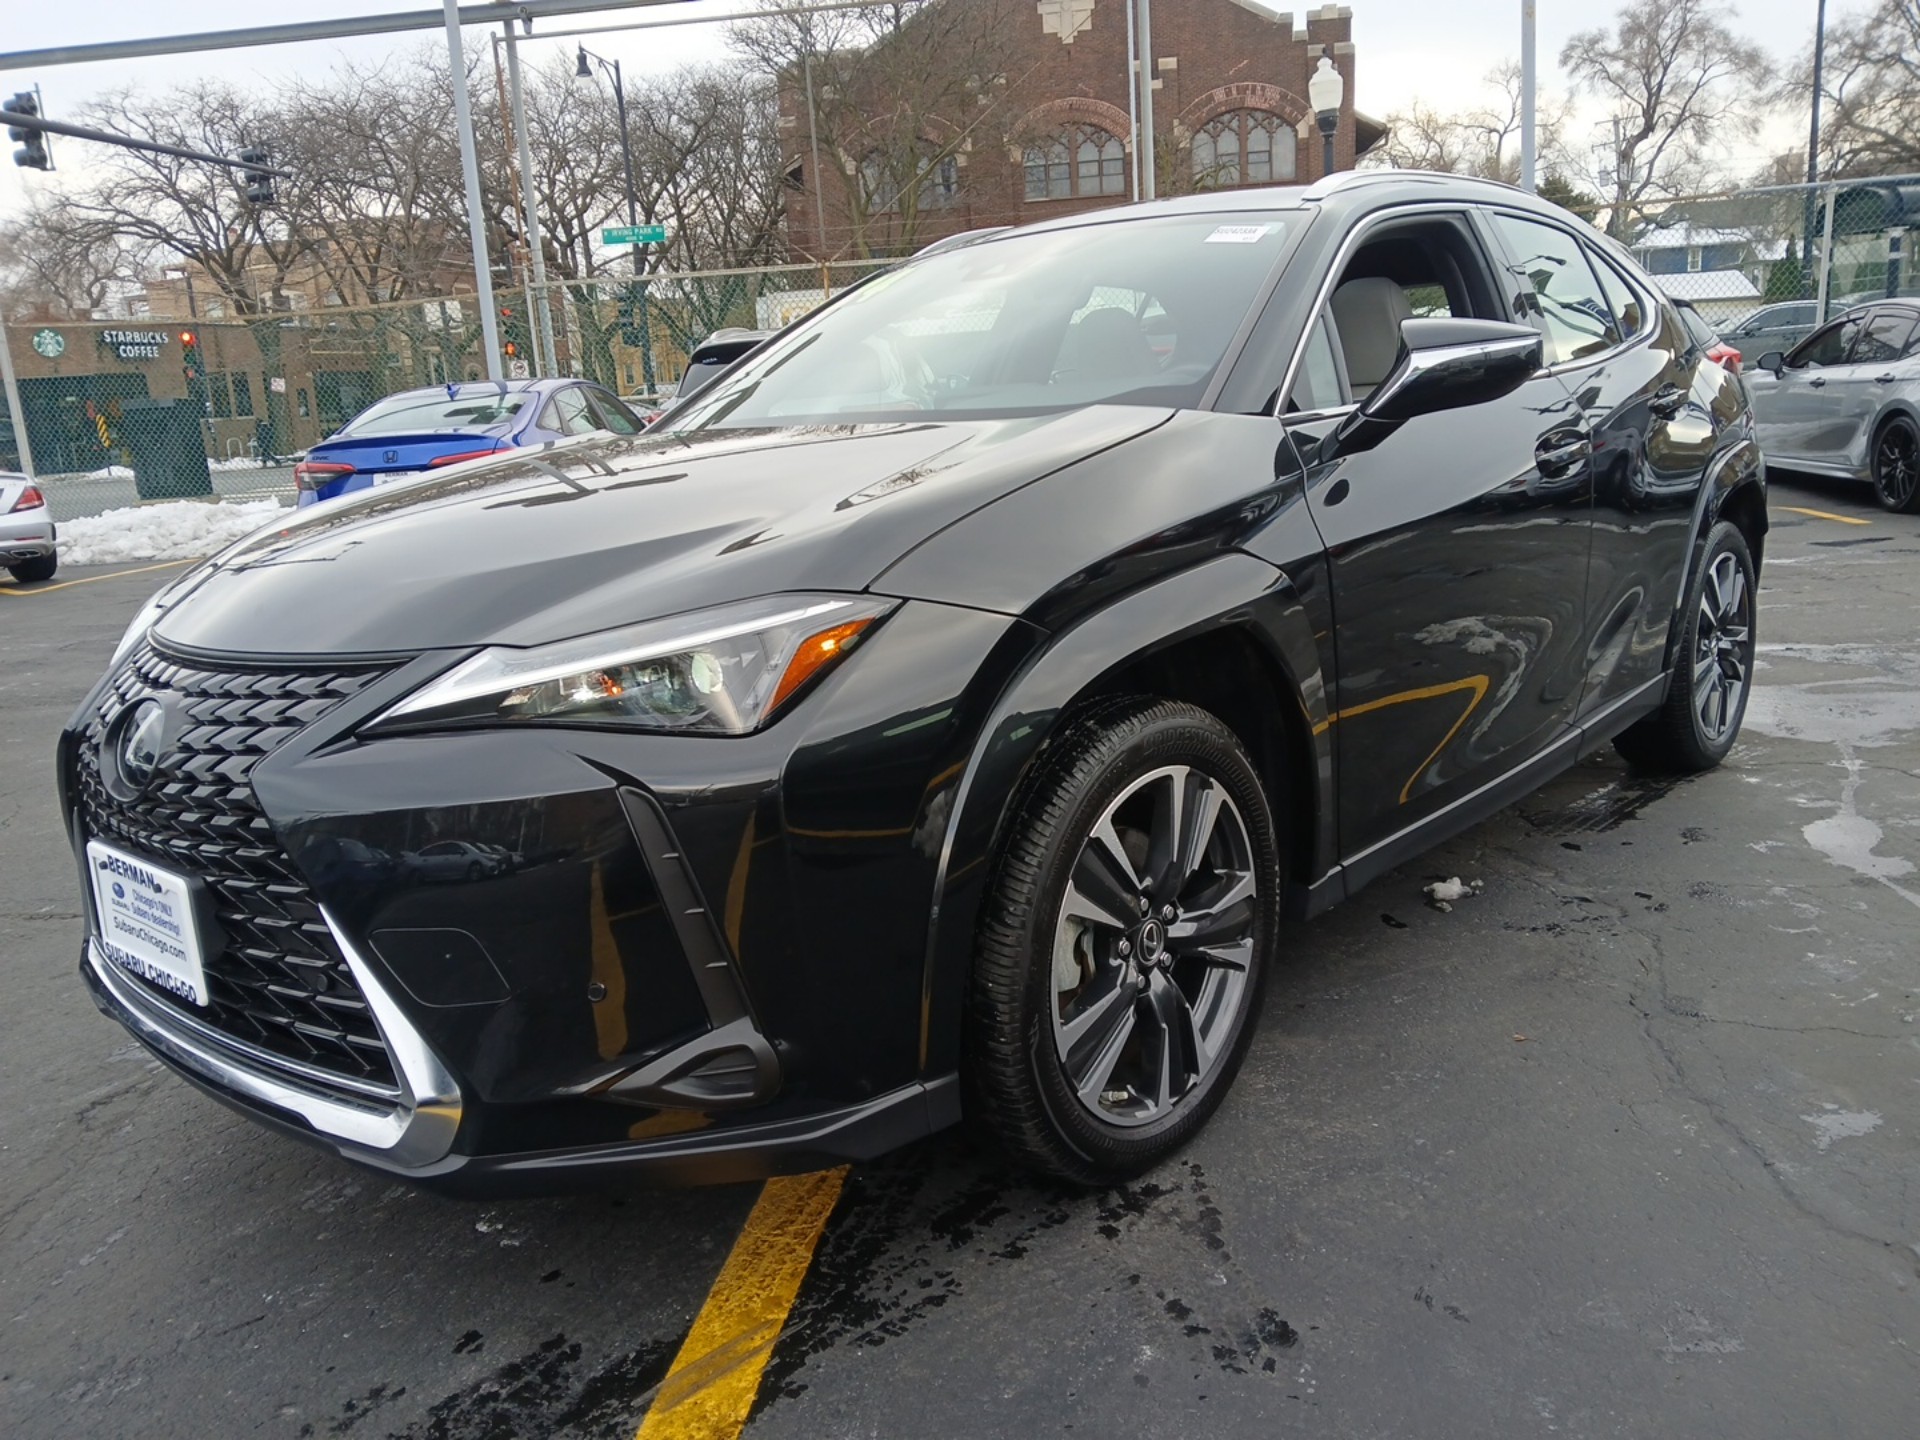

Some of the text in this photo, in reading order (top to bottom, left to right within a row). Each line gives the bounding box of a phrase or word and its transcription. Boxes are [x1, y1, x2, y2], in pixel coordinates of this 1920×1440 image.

[634, 227, 652, 235] PARK
[103, 330, 169, 344] STARBUCKS
[119, 345, 160, 358] COFFEE
[1143, 727, 1225, 749] BRIDGESTONE
[106, 854, 156, 889] BERMAN
[111, 897, 130, 911] SUBARU
[131, 902, 151, 921] Subaru
[132, 888, 173, 917] Chicago's ONLY
[113, 916, 188, 963] SubaruChicago.com
[104, 942, 197, 1004] SUBARU CHICAGO
